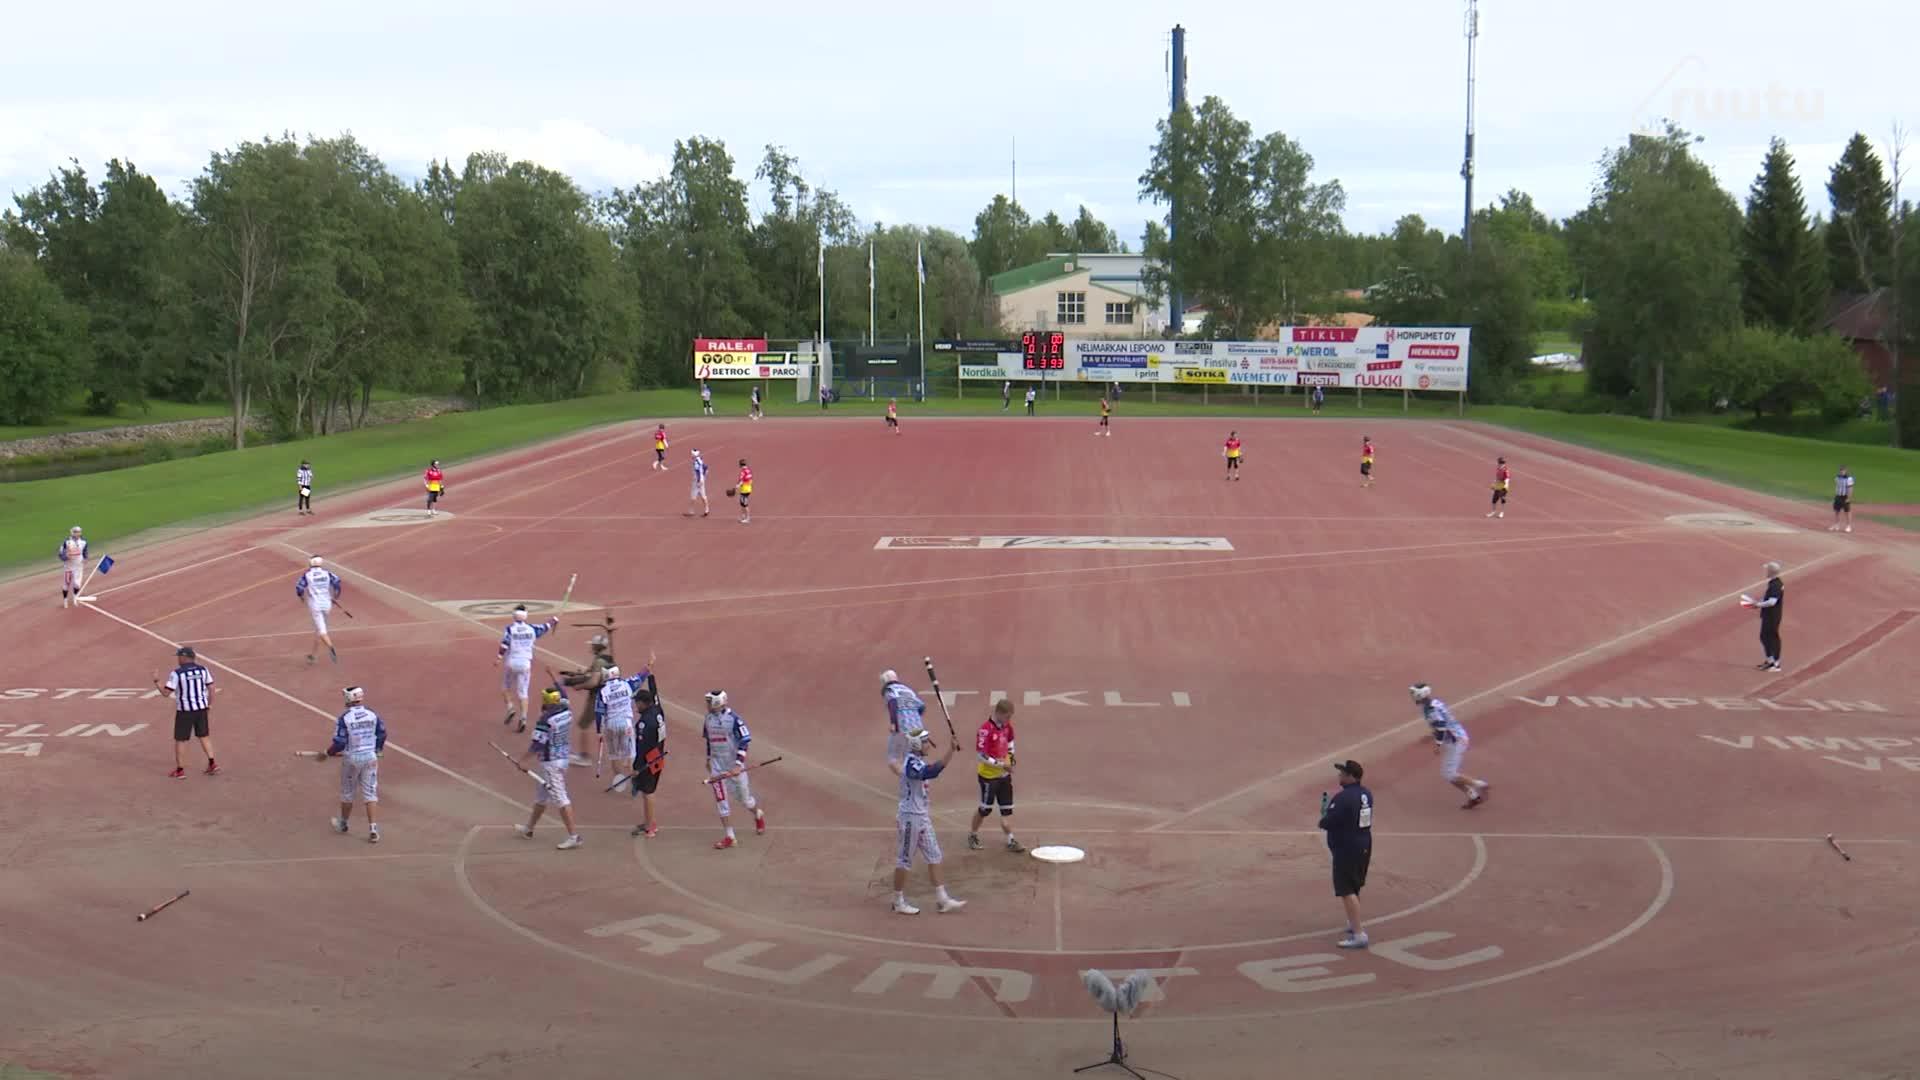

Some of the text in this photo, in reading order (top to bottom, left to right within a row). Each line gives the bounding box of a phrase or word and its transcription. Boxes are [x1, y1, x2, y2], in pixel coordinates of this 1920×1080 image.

[1299, 331, 1345, 340] TIKLI
[1396, 331, 1457, 341] HONPUMET OY
[708, 342, 754, 351] RALE.fi
[1129, 343, 1166, 353] LEIPOMO
[1323, 347, 1338, 357] OIL
[1204, 358, 1238, 368] Finsilva
[712, 368, 751, 376] BETROC
[962, 368, 1007, 377] Nordkalk
[1186, 370, 1225, 378] SOTKA
[1230, 372, 1288, 383] AVEMET OY
[919, 690, 1193, 706] TIKLI
[1512, 695, 1889, 713] VIMPELIN
[1697, 734, 1920, 751] VIMP
